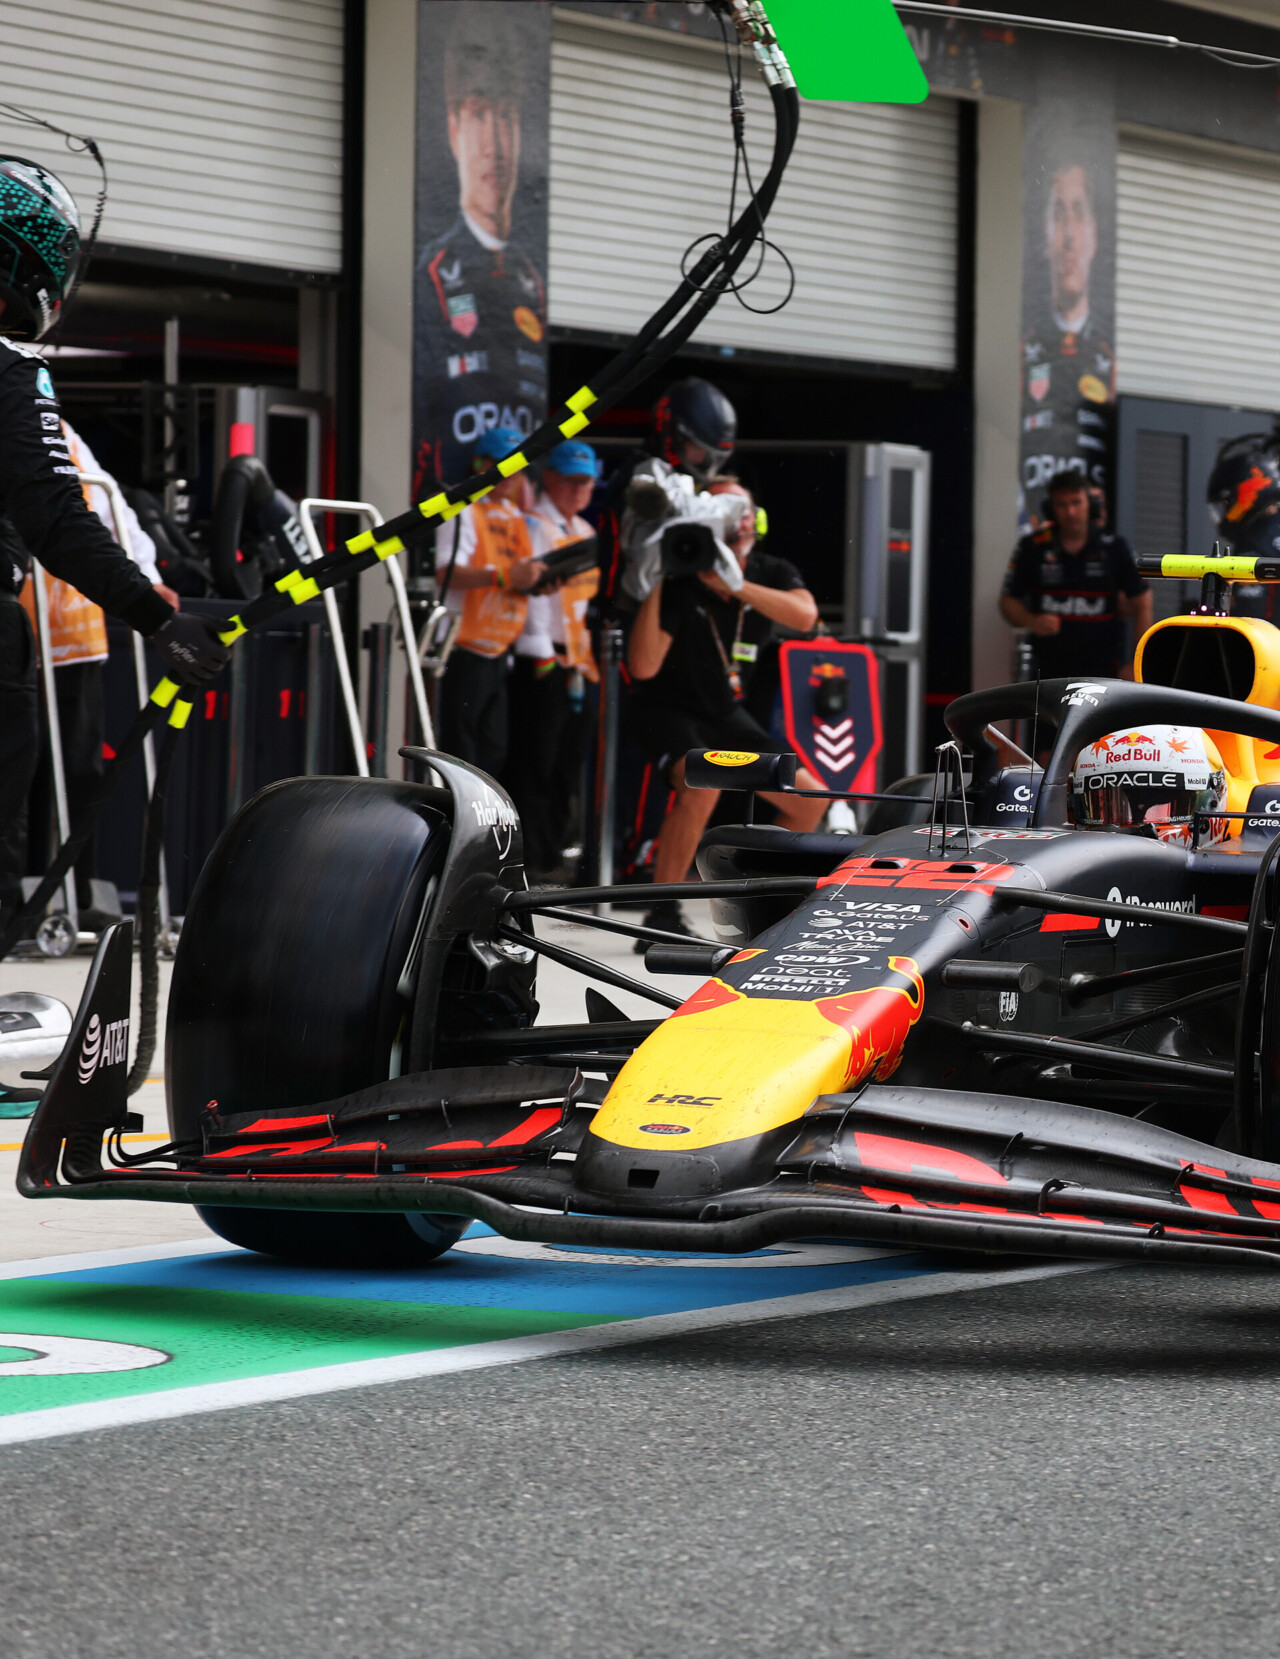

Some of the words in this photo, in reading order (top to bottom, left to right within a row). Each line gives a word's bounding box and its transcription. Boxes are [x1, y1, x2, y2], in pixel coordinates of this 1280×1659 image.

[718, 753, 752, 761] RAUCH
[1106, 750, 1131, 764] Red
[1133, 749, 1161, 762] Bull
[1088, 772, 1177, 790] ORACLE
[841, 901, 922, 914] VISA
[844, 921, 915, 930] AT&T
[798, 932, 896, 943] TRADE
[822, 928, 877, 937] AVA
[773, 954, 850, 964] CDW
[748, 974, 851, 986] PIRELLI
[739, 982, 815, 993] Mobil
[99, 1018, 130, 1068] AT&T
[646, 1093, 723, 1107] HRC
